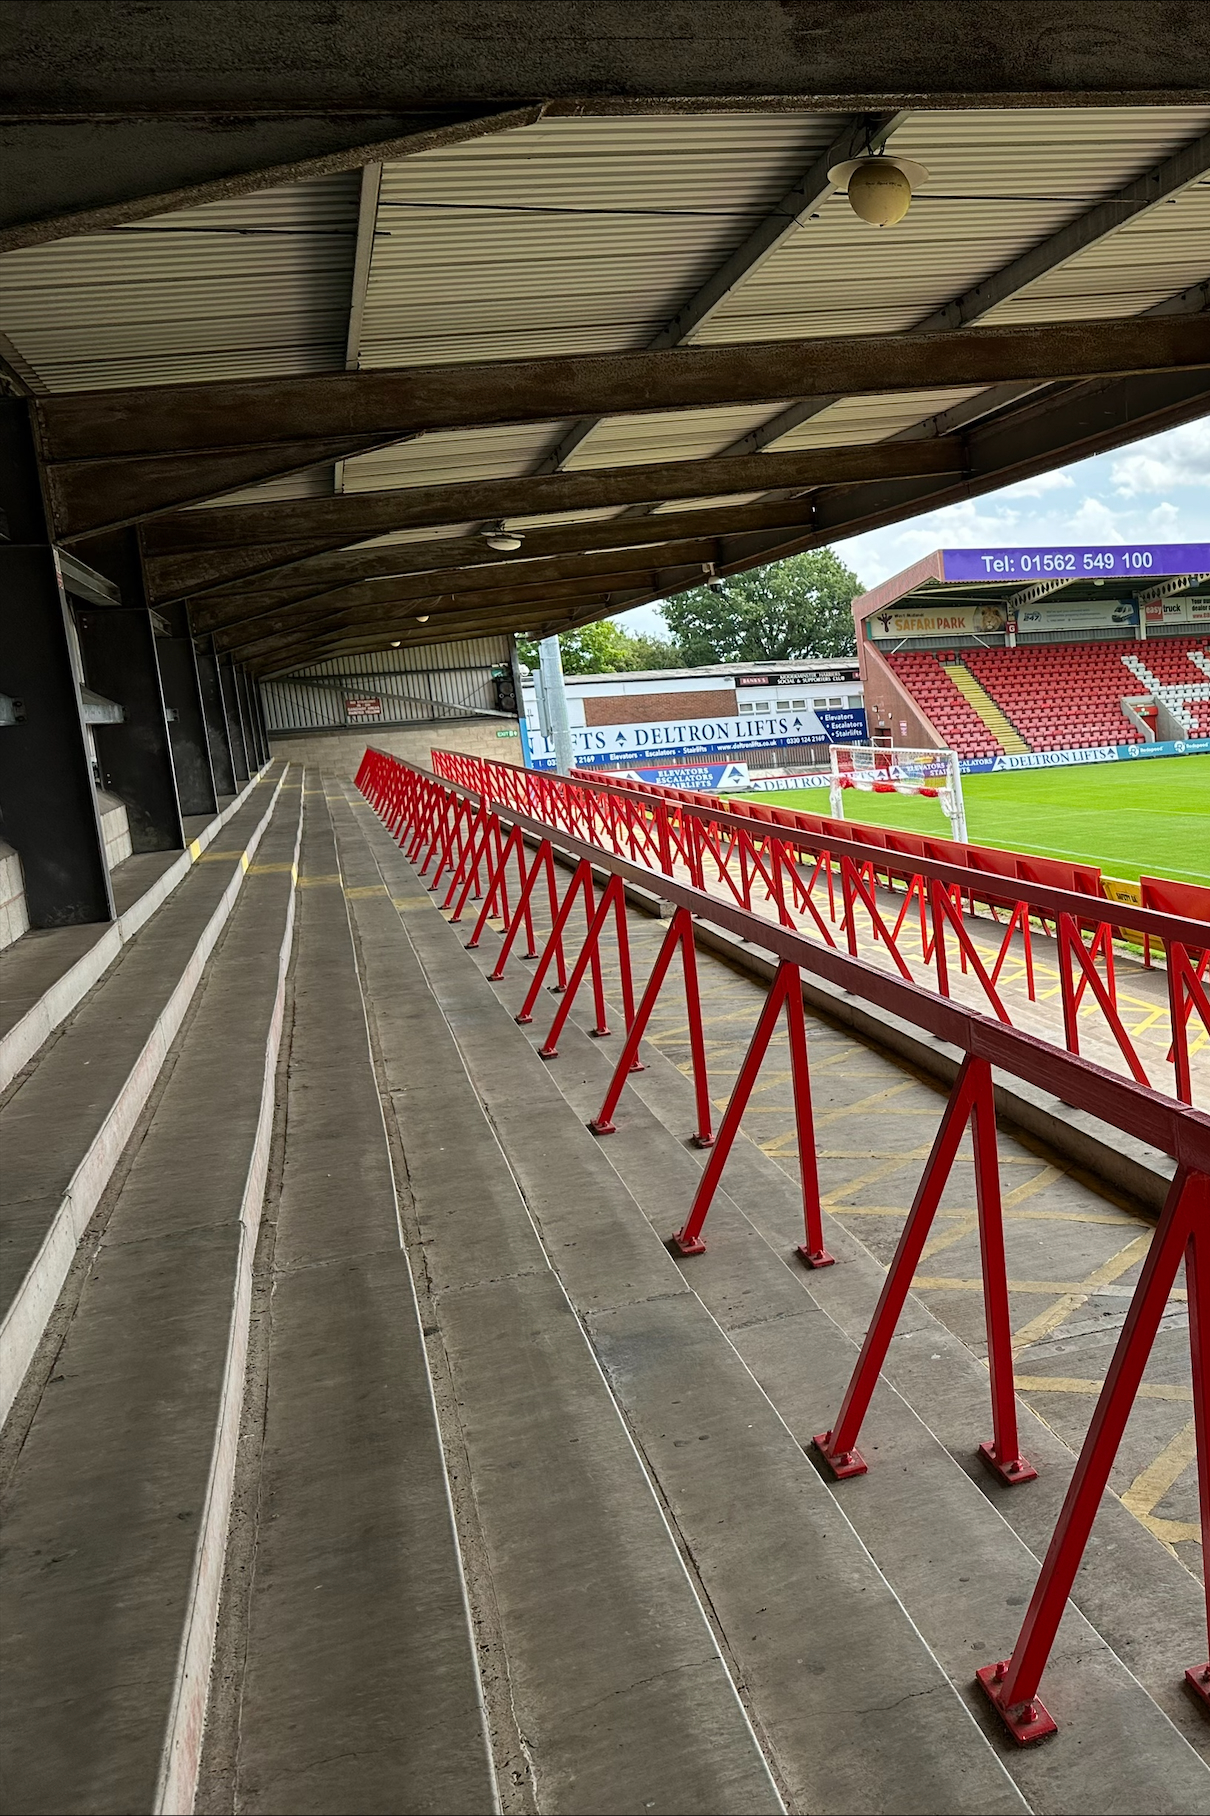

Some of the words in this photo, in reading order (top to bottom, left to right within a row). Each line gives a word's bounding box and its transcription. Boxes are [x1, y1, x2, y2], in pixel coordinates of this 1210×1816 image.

[981, 556, 1016, 573] Tel:
[1020, 554, 1077, 572] 01562
[1083, 552, 1115, 570] 549
[1122, 551, 1153, 569] 100
[1145, 604, 1163, 615] easy
[1163, 604, 1181, 613] truck
[895, 618, 935, 631] SAFARI
[936, 617, 966, 629] PARK
[824, 713, 853, 721] Elevators
[831, 721, 863, 729] Escalators
[634, 722, 730, 747] DELTRON
[735, 718, 788, 738] LIFTS
[835, 729, 862, 737] Stairlifts
[801, 736, 811, 744] 124
[644, 749, 676, 757] Escalators
[683, 745, 708, 754] Stairlifts
[717, 740, 777, 752] www.deltronlifts.co.uk
[1010, 752, 1072, 768] DELTRON
[1073, 749, 1107, 762] LIFTS
[658, 767, 710, 778] ELEVATORS
[656, 774, 714, 784] ESCALATORS
[764, 774, 830, 792] DELTRON
